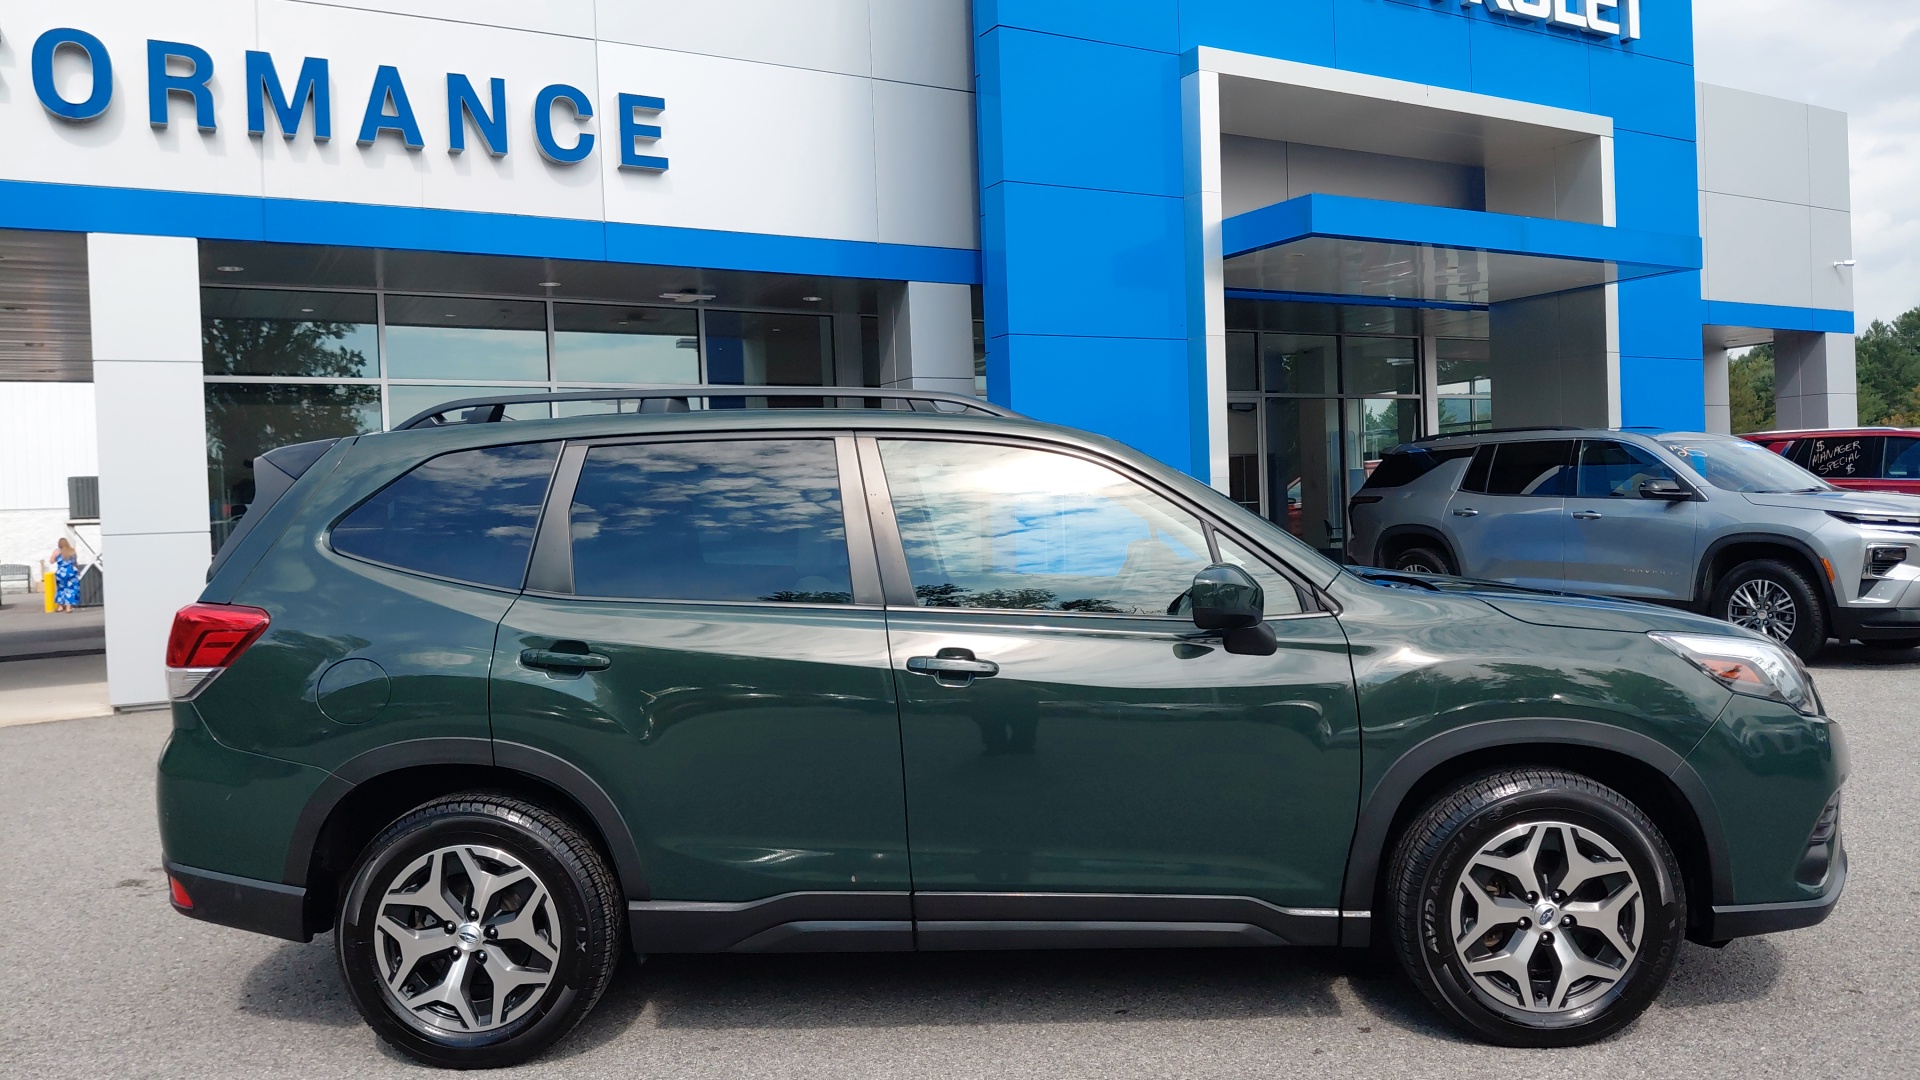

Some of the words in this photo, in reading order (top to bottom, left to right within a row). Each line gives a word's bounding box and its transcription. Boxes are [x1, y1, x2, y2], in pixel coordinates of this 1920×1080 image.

[31, 27, 669, 173] ORMANCE
[1812, 440, 1861, 467] MANAGER
[1424, 899, 1440, 954] AVID
